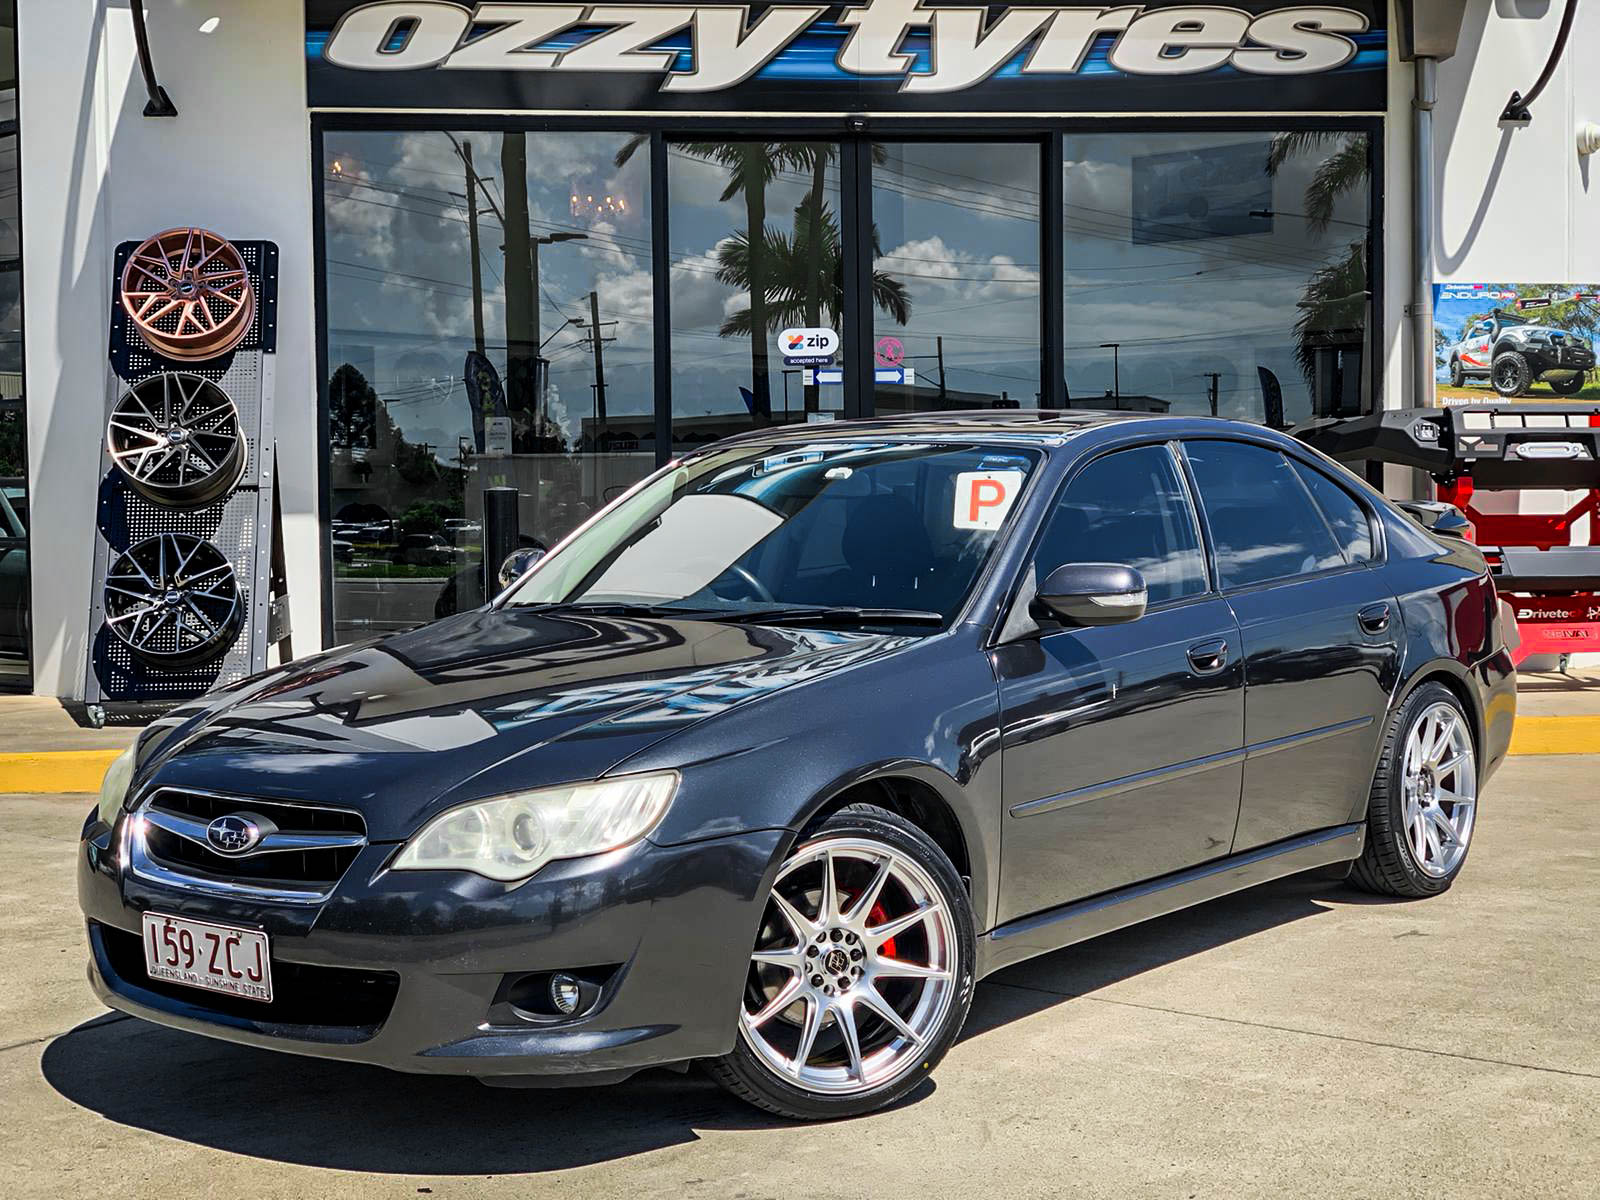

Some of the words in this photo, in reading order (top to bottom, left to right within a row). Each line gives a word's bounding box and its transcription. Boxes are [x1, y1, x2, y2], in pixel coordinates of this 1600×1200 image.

[321, 0, 831, 93] ozzy
[835, 0, 1370, 93] tyres
[807, 334, 829, 349] zip
[1442, 397, 1469, 405] Driven
[969, 479, 1006, 522] P
[1517, 608, 1584, 619] Drivetec
[151, 922, 195, 970] 159
[205, 932, 263, 982] ZCJ
[150, 966, 198, 983] QUEENSLAND
[205, 976, 240, 991] SUNSHINE
[243, 983, 267, 998] STATE
